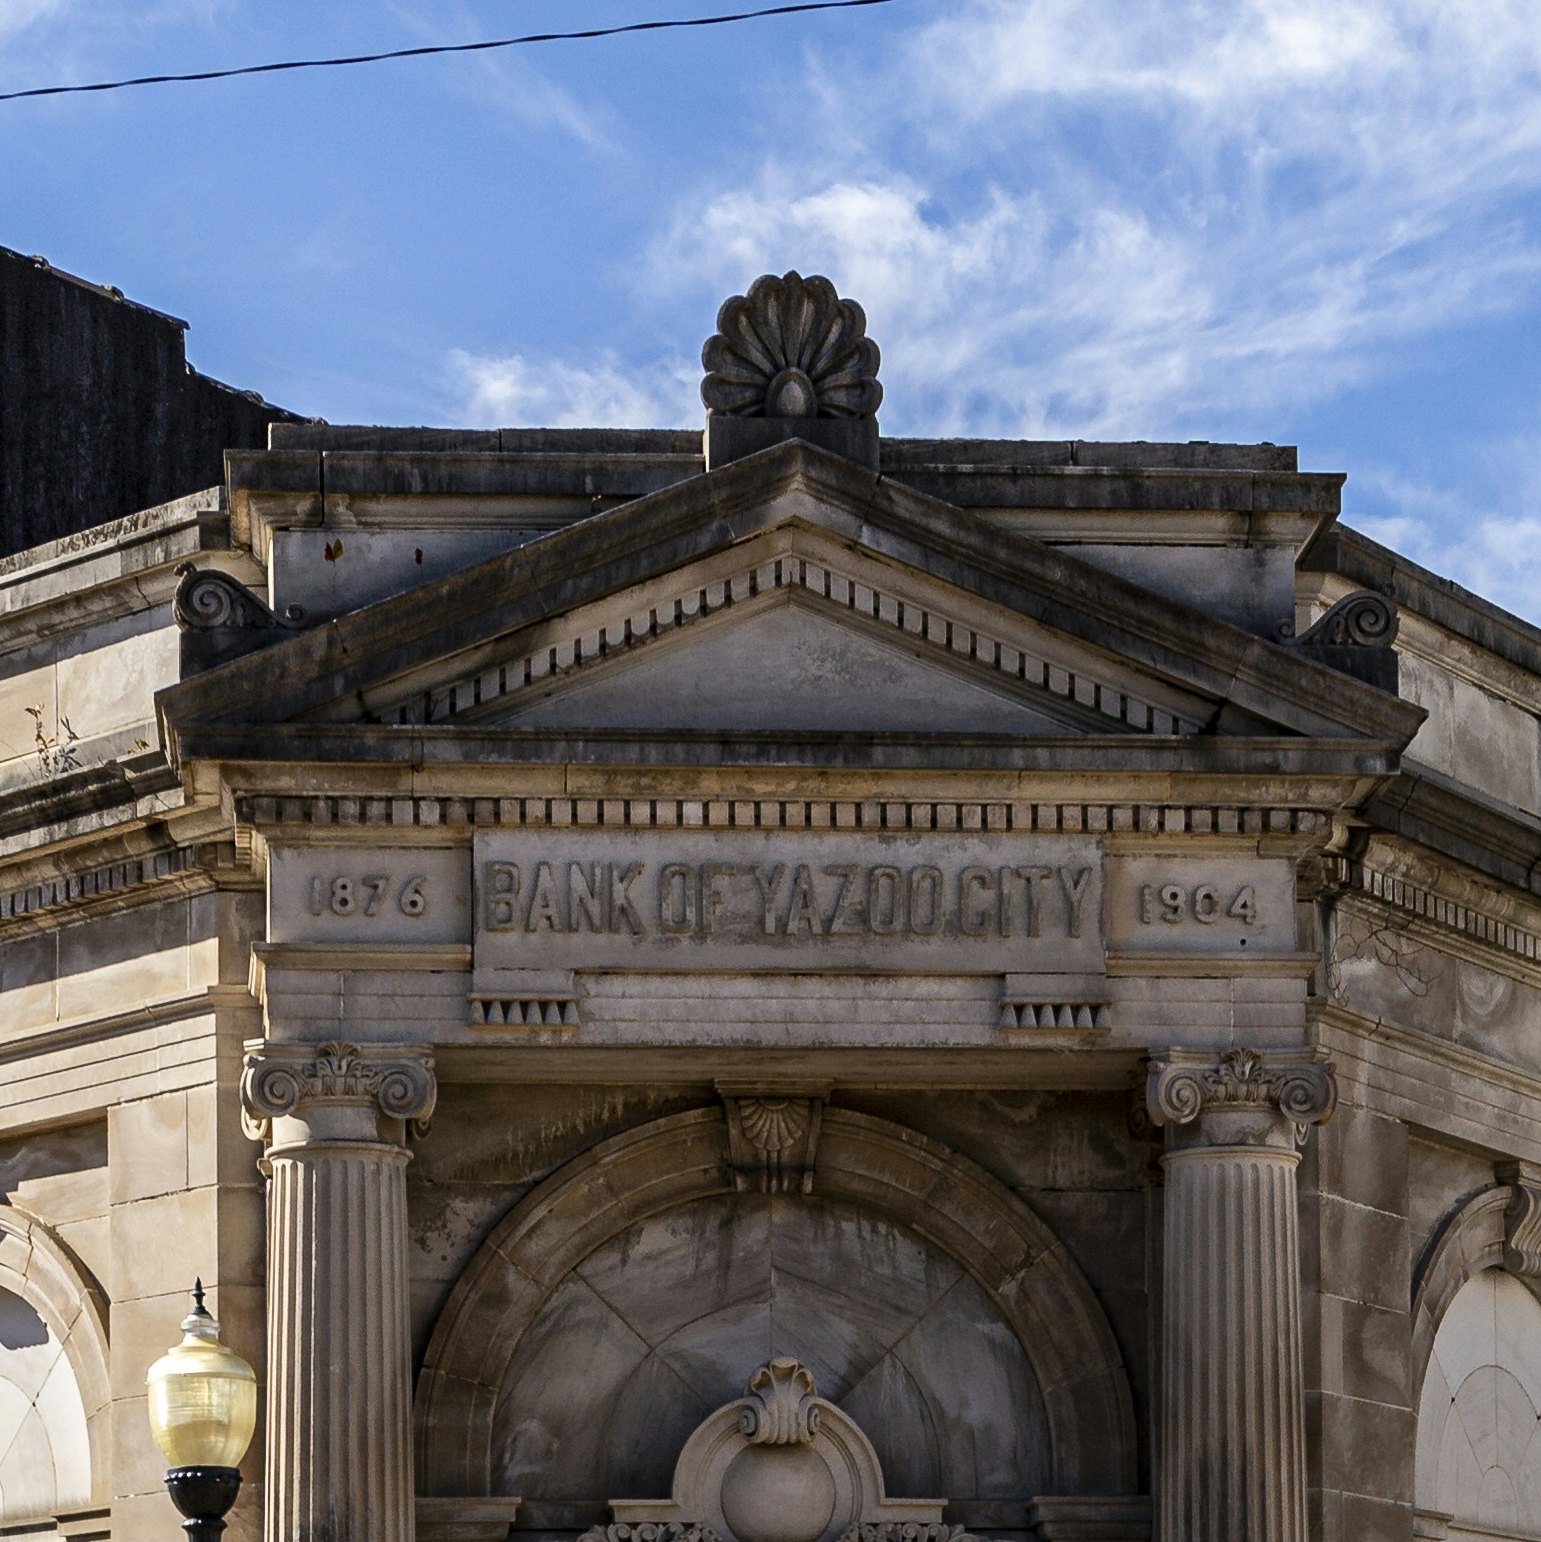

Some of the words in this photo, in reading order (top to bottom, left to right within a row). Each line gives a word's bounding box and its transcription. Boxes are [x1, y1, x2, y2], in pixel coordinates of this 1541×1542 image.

[308, 873, 428, 917] 1876
[485, 860, 645, 936] BANK
[660, 862, 743, 936] OF
[755, 862, 944, 937] YAZOO
[960, 865, 1093, 938] CITY
[1139, 884, 1257, 925] 1904
